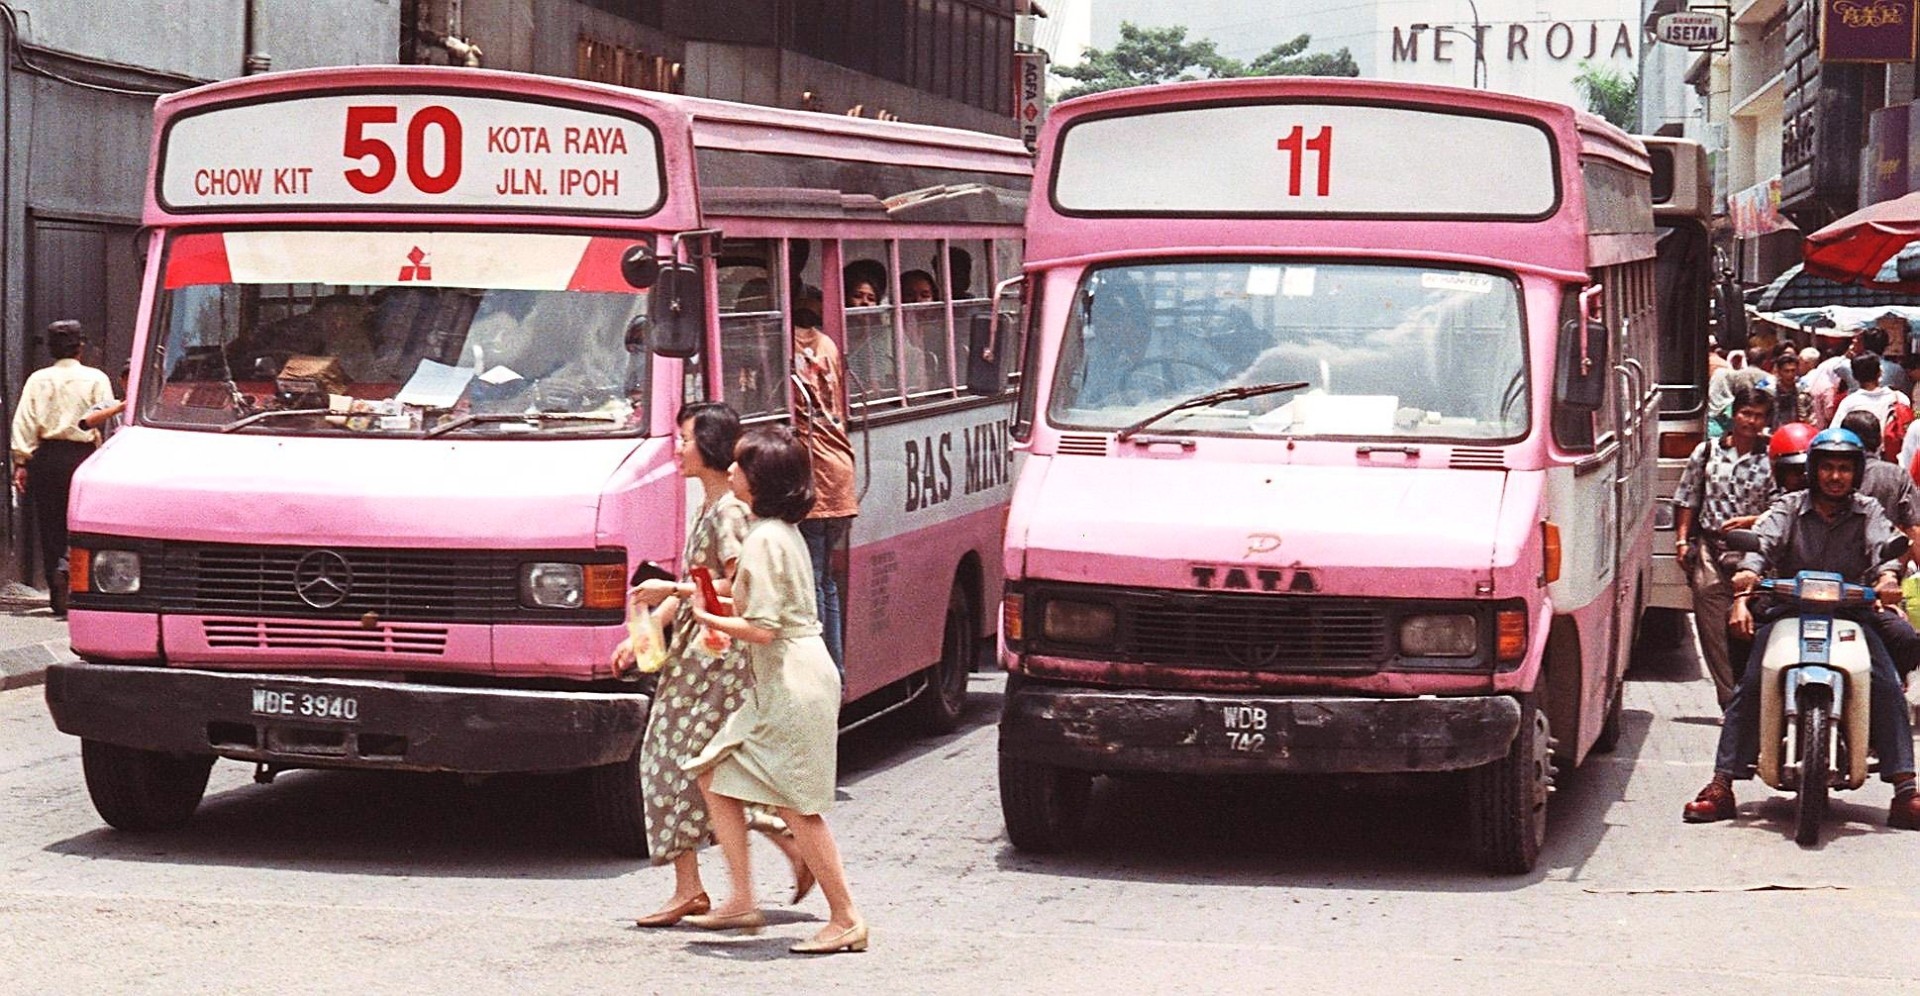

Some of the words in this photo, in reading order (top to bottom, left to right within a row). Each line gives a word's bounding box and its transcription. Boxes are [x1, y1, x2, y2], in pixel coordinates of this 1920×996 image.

[1666, 26, 1718, 40] ISETAN
[1025, 62, 1037, 100] AGFA
[343, 105, 463, 195] 50
[488, 127, 551, 154] KOTA
[564, 127, 627, 155] RAYA
[1277, 125, 1332, 197] 11
[195, 169, 262, 196] CHOW
[273, 167, 313, 194] KIT
[496, 168, 547, 196] JLN.
[559, 169, 619, 196] IPOH
[905, 432, 952, 513] BAS
[1192, 566, 1316, 593] TATA
[299, 693, 358, 719] 3940
[1223, 706, 1268, 730] WDB
[1226, 732, 1266, 752] 742
